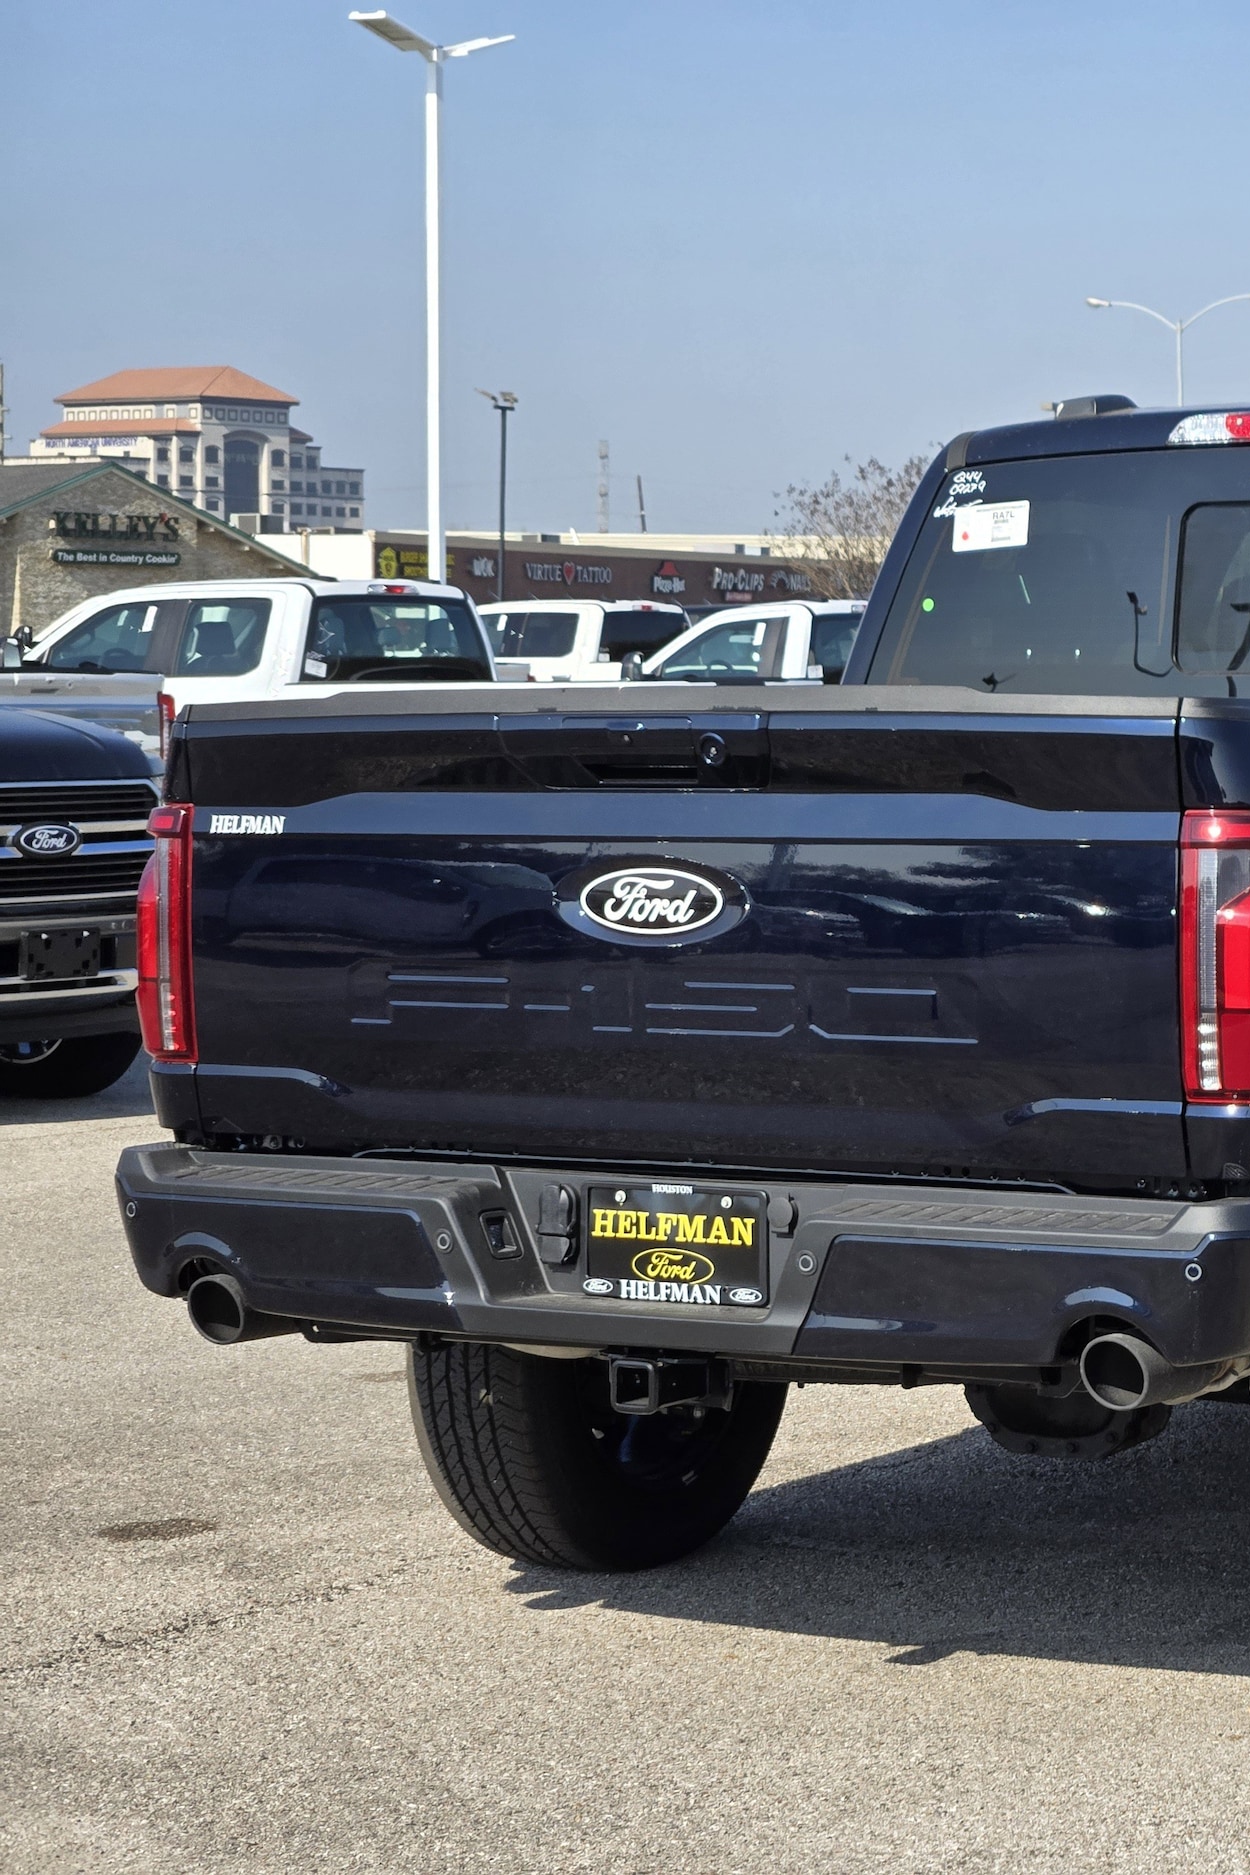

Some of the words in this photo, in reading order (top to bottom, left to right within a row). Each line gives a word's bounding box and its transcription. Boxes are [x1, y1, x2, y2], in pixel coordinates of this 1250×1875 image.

[53, 511, 179, 541] KELLEY'S
[58, 552, 74, 561] The
[76, 552, 97, 561] Best
[109, 554, 144, 565] Country
[526, 563, 562, 582] VIRTUE
[576, 566, 612, 584] TATTOO
[210, 815, 286, 835] HELFMAN
[32, 829, 67, 849] Ford
[604, 876, 698, 923] Ford
[651, 1183, 693, 1195] HOUSTON
[591, 1208, 756, 1246] HELFMAN
[646, 1252, 698, 1280] Ford
[620, 1279, 722, 1305] HELFMAN
